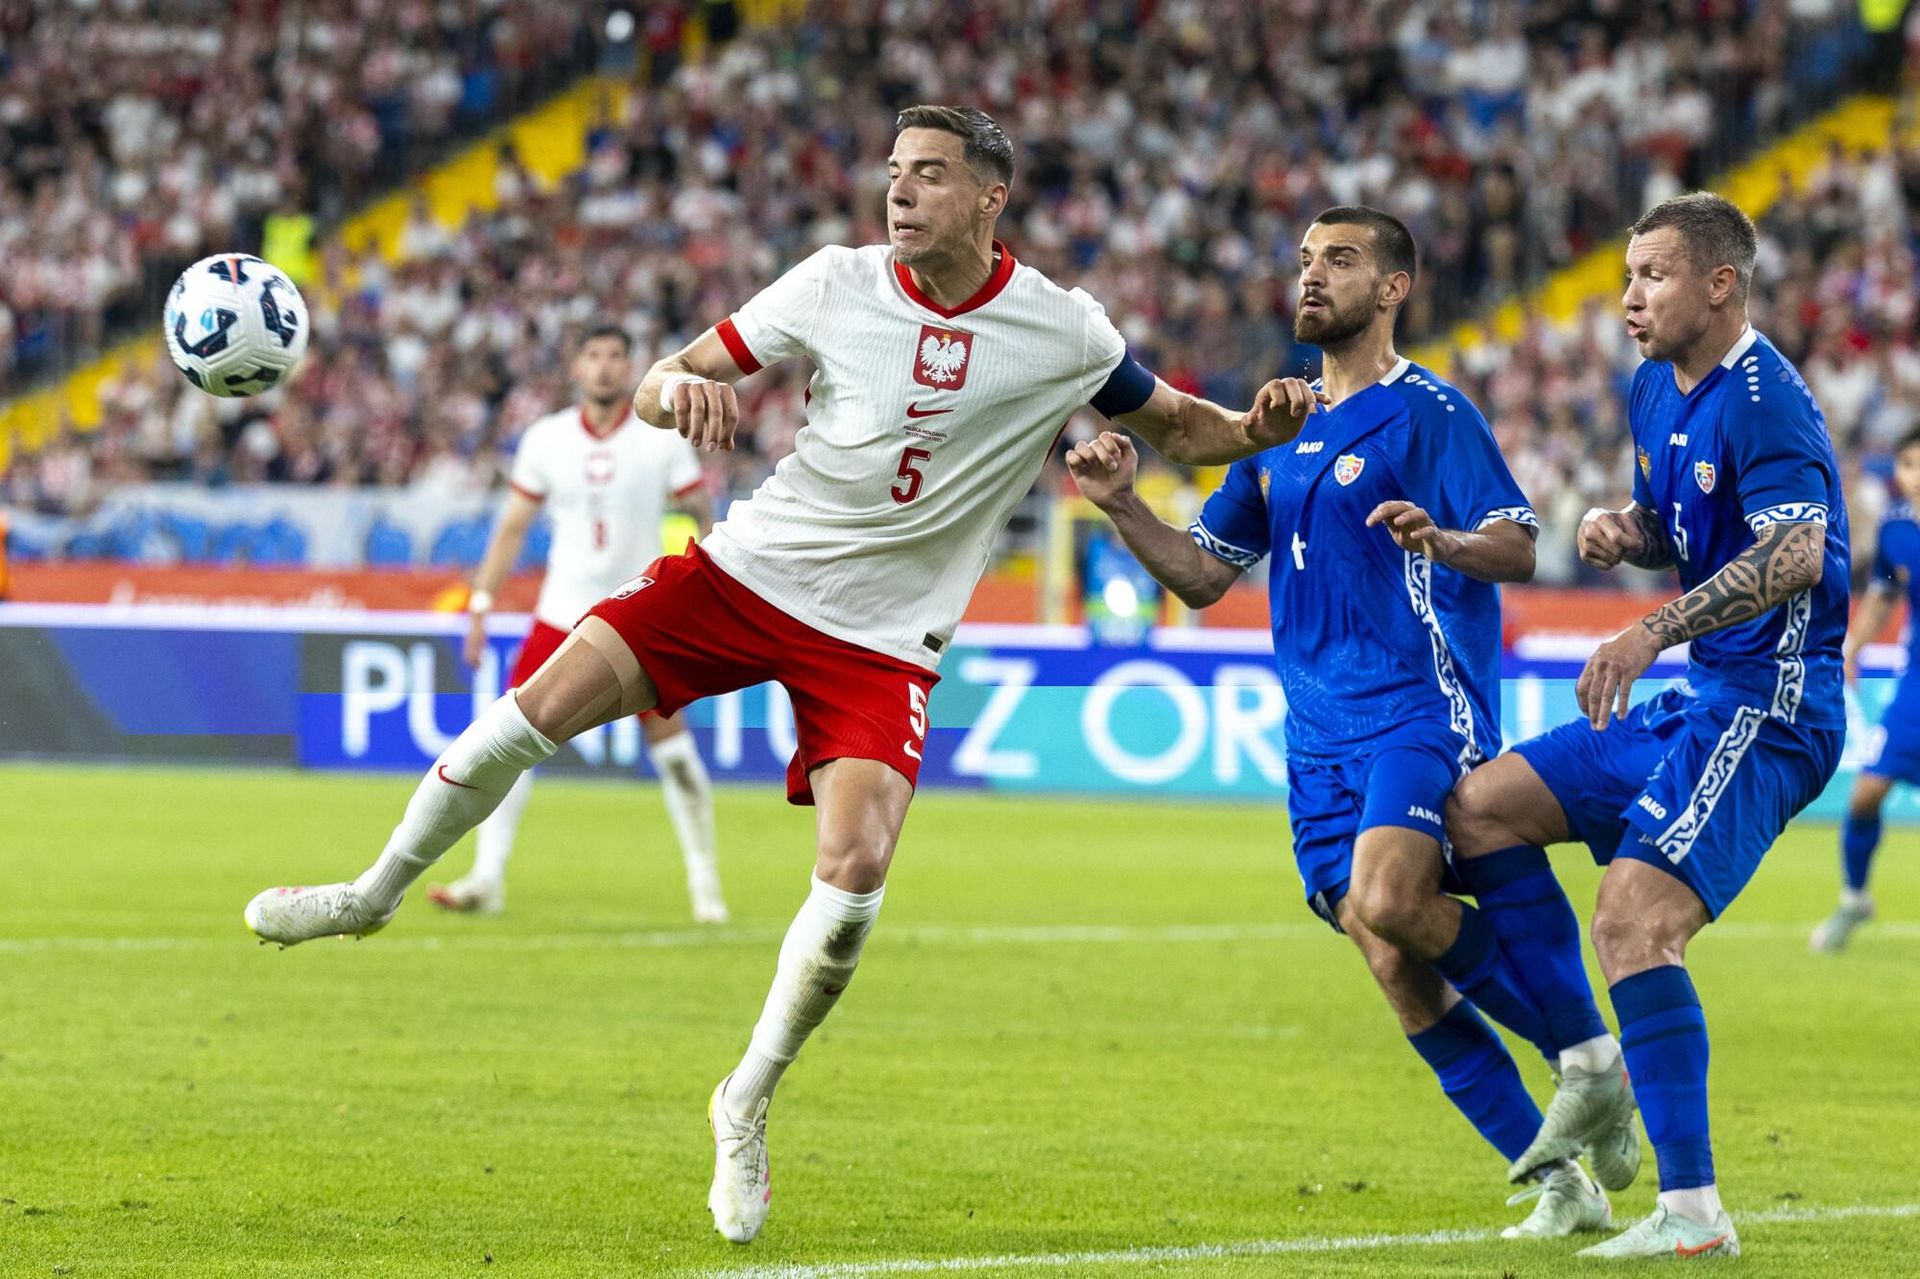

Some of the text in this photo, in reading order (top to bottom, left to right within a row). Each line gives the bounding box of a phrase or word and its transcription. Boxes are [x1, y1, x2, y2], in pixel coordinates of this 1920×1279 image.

[1296, 441, 1324, 454] JAKO
[891, 447, 931, 505] 5
[908, 682, 927, 740] 5
[953, 658, 1038, 776] Z
[1407, 805, 1442, 826] JAKO
[1637, 794, 1667, 820] JAKO
